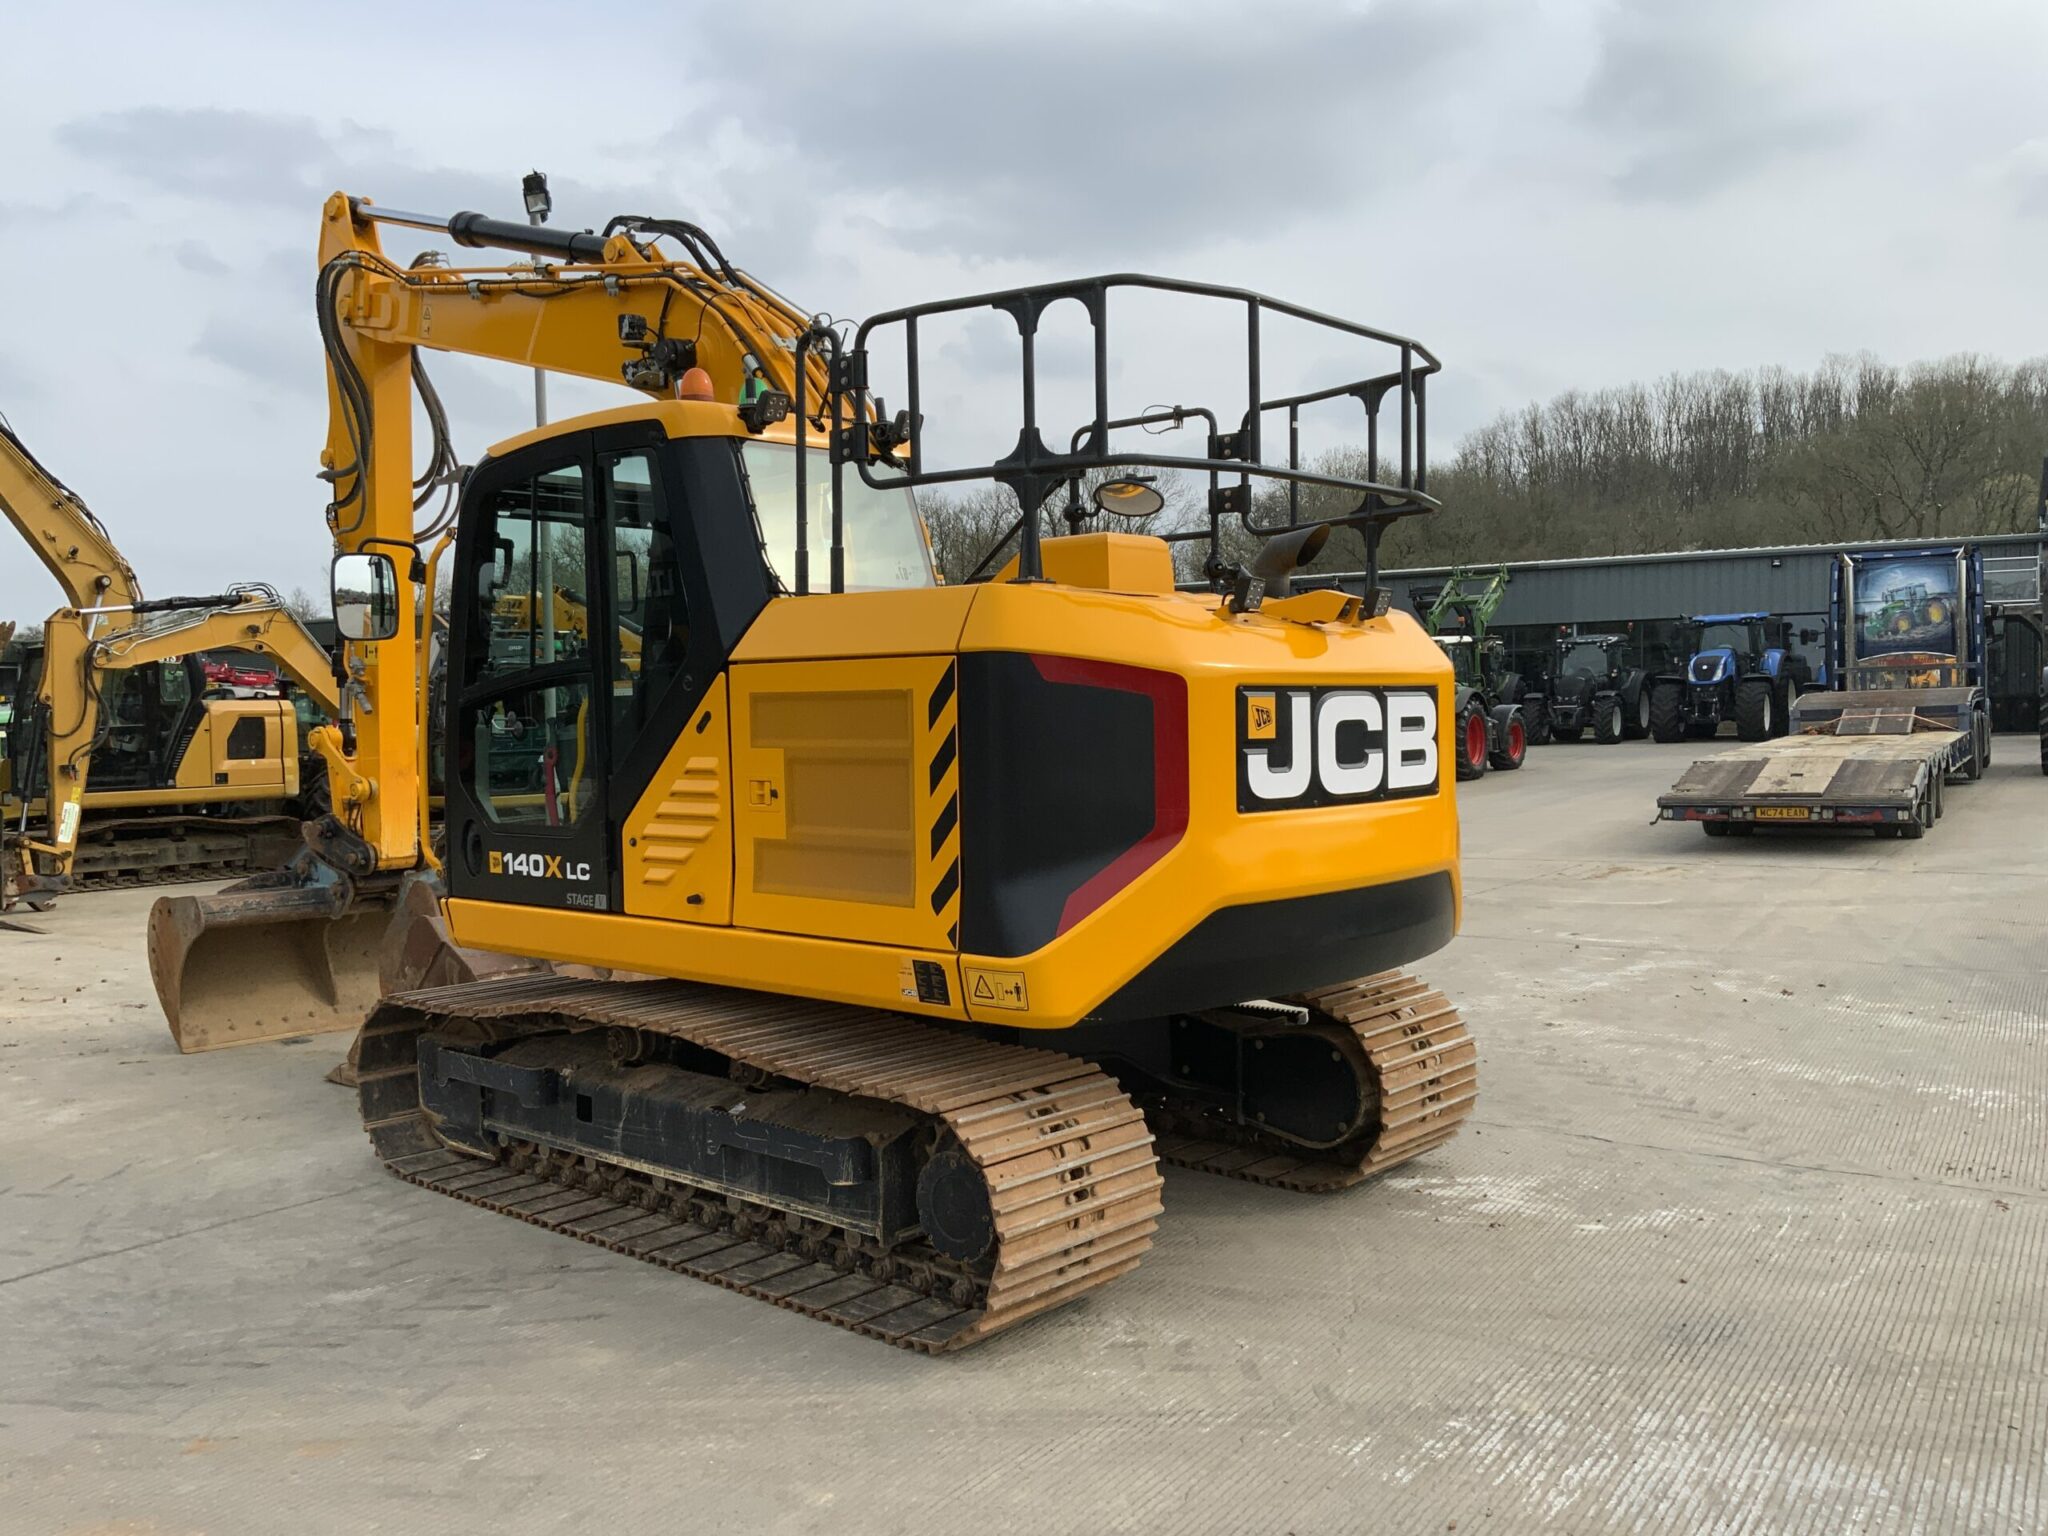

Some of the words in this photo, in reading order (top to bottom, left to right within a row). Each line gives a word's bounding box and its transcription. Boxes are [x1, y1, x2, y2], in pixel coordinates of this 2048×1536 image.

[1254, 707, 1273, 728] JCB
[1244, 691, 1438, 799] JCB
[503, 853, 563, 879] 140X
[566, 862, 590, 881] LC
[566, 893, 594, 907] STAGE
